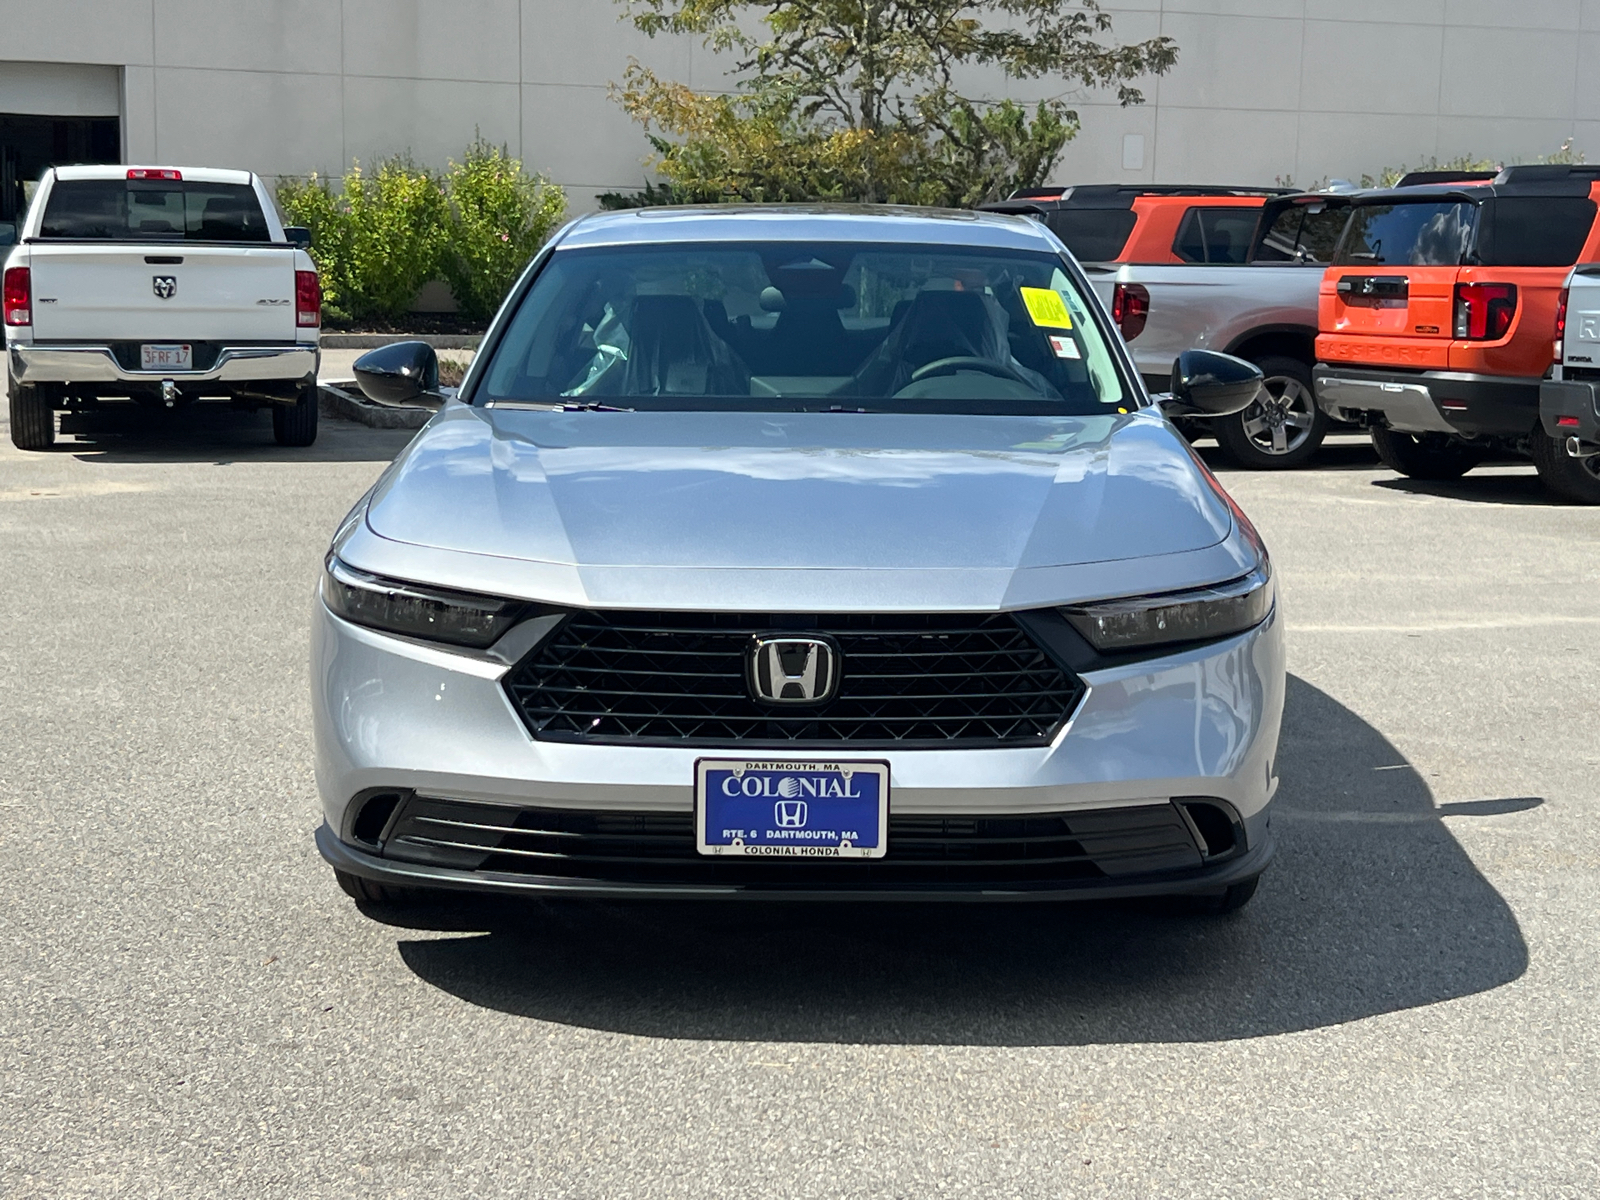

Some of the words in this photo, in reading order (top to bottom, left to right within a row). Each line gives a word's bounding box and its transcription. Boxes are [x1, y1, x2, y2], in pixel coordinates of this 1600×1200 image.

[144, 350, 172, 363] 3FRF
[175, 350, 189, 364] 17
[1319, 342, 1431, 361] PASSPORT
[823, 763, 841, 771] MA
[721, 776, 861, 799] COLONIAL
[722, 829, 748, 839] RTE.
[749, 829, 758, 839] 6
[765, 830, 839, 841] DARTMOUTH,
[840, 831, 859, 840] MA
[744, 846, 798, 856] COLONIAL
[800, 847, 840, 857] HONDA
